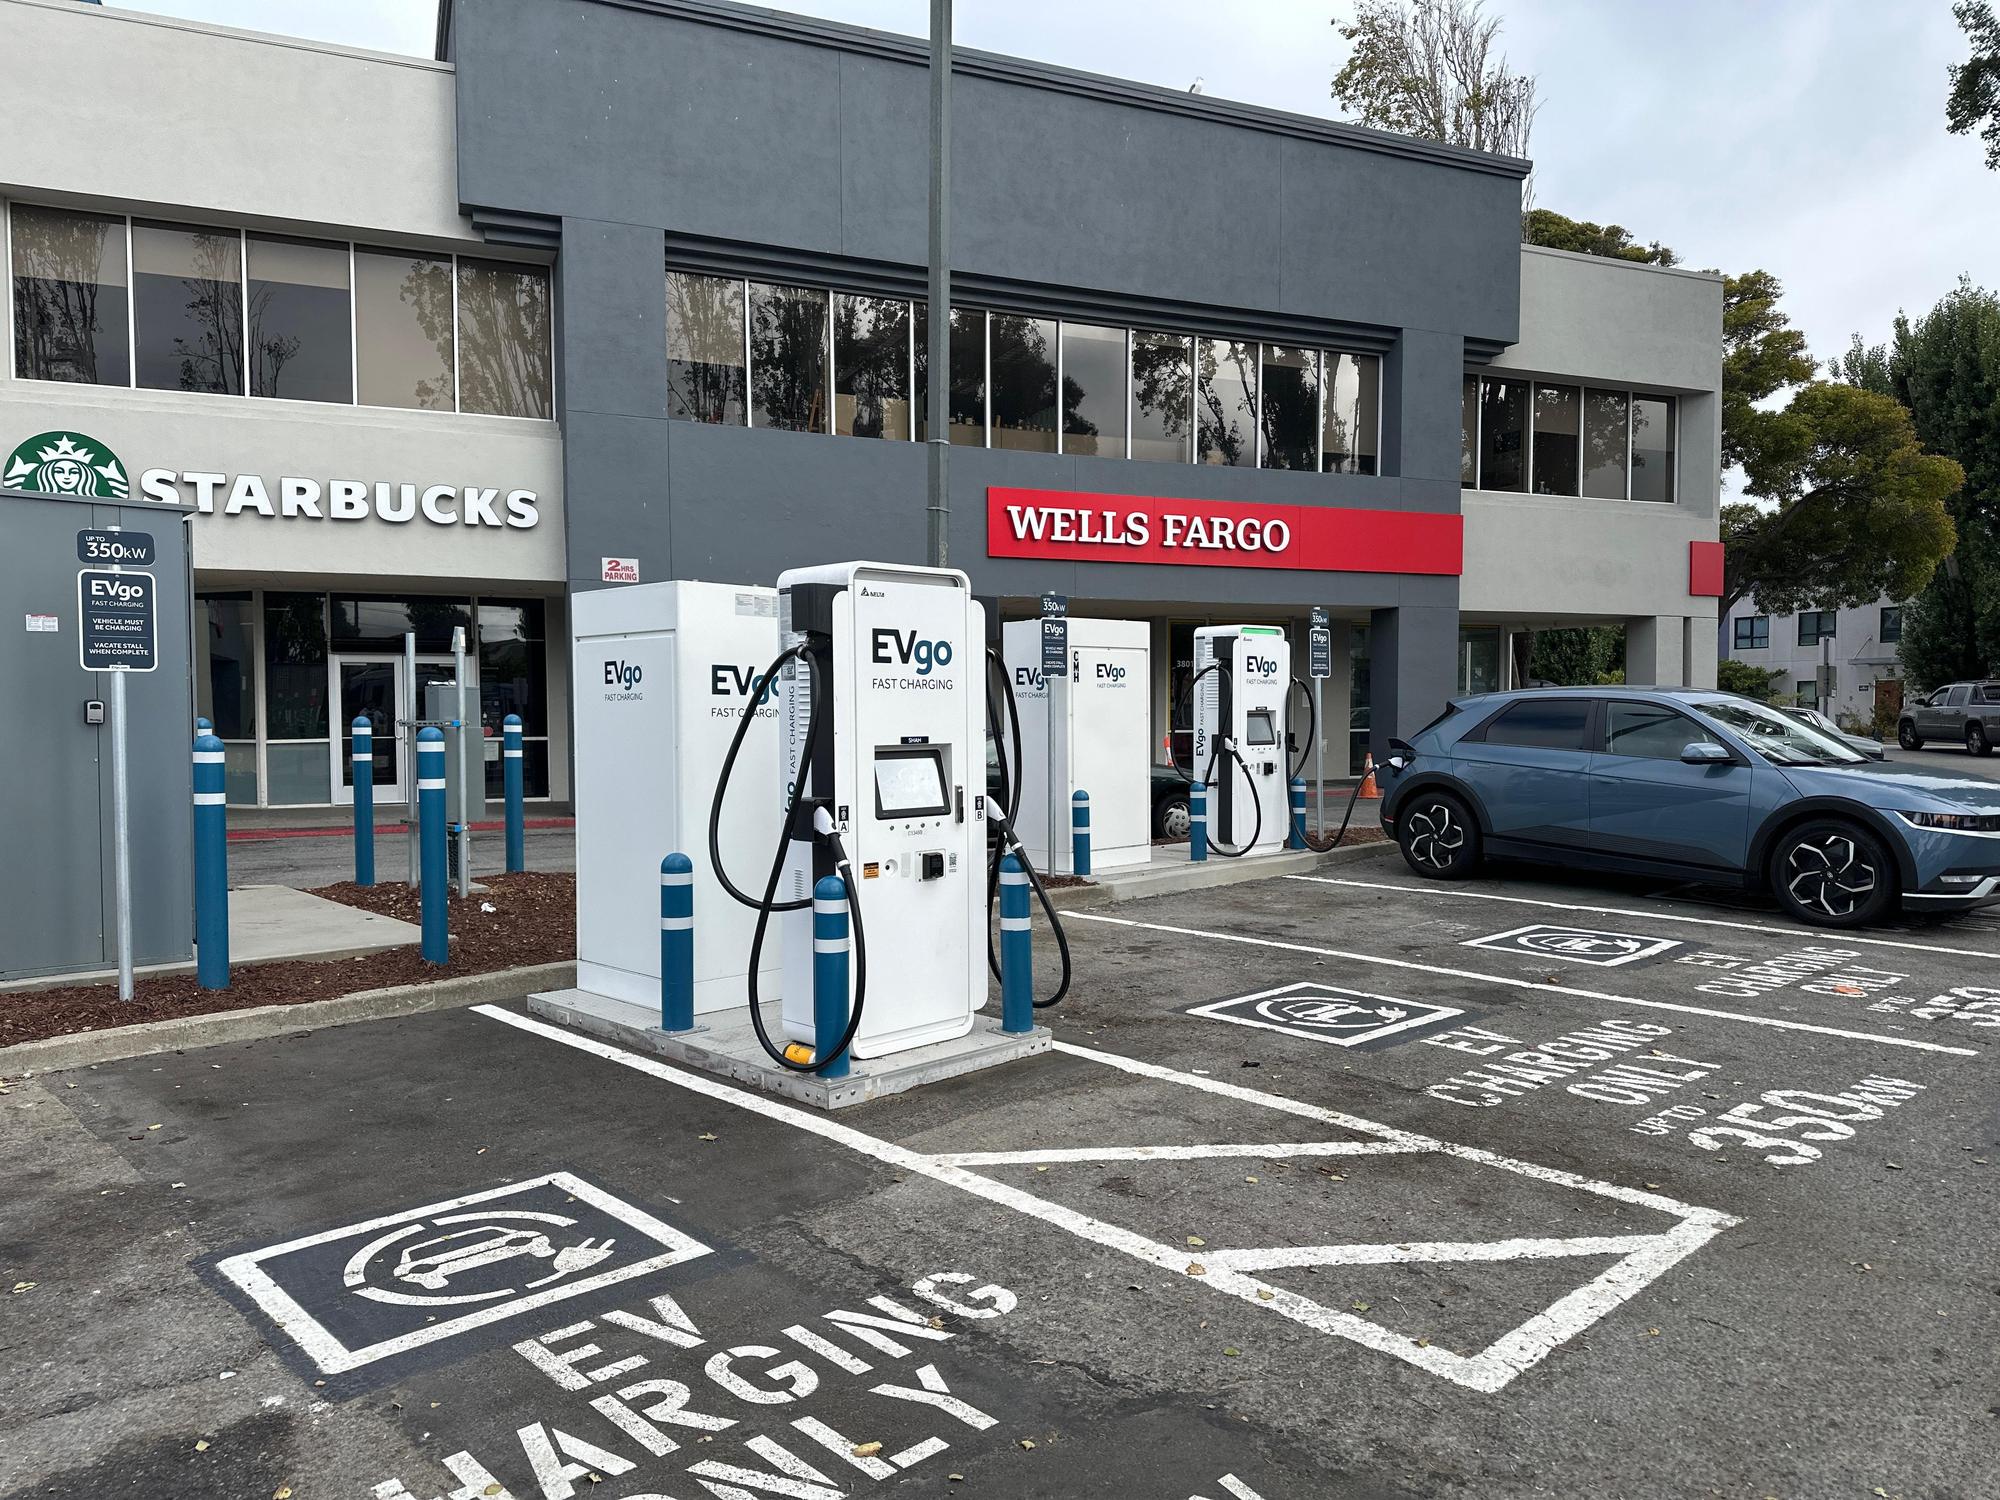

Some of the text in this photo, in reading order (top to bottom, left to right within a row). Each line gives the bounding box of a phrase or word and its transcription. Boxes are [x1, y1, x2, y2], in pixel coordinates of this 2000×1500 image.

[140, 468, 540, 529] STARBUCKS
[1006, 505, 1291, 552] WELLS FARGO
[86, 542, 147, 559] 350kW
[604, 572, 637, 581] PARKING
[607, 560, 620, 571] 2
[91, 580, 144, 601] EVgo
[1044, 623, 1064, 636] EVgo
[1313, 633, 1327, 643] EVgo
[872, 628, 953, 675] EVgo
[604, 660, 642, 690] EVgo
[1096, 663, 1126, 682] EVgo
[1176, 660, 1194, 668] 3801
[1247, 655, 1277, 677] EVgo
[872, 678, 953, 690] FAST CHARGING
[1015, 667, 1048, 691] EVg
[604, 693, 616, 701] FAST
[711, 707, 779, 718] FAST CARGIN
[1196, 728, 1206, 756] EVgo
[840, 822, 847, 831] A
[977, 811, 982, 819] B
[1673, 951, 1751, 969] EV
[1694, 947, 1862, 997] CHARGING
[1800, 965, 1910, 998] ONLY
[1419, 1026, 1524, 1056] EV
[1422, 1020, 1672, 1107] CHARGING
[1566, 1052, 1722, 1105] ONLY
[1629, 1104, 1707, 1136] UP TO
[512, 1293, 707, 1391] EV
[370, 1272, 1018, 1500] HARGING
[617, 1363, 1000, 1500] NLY
